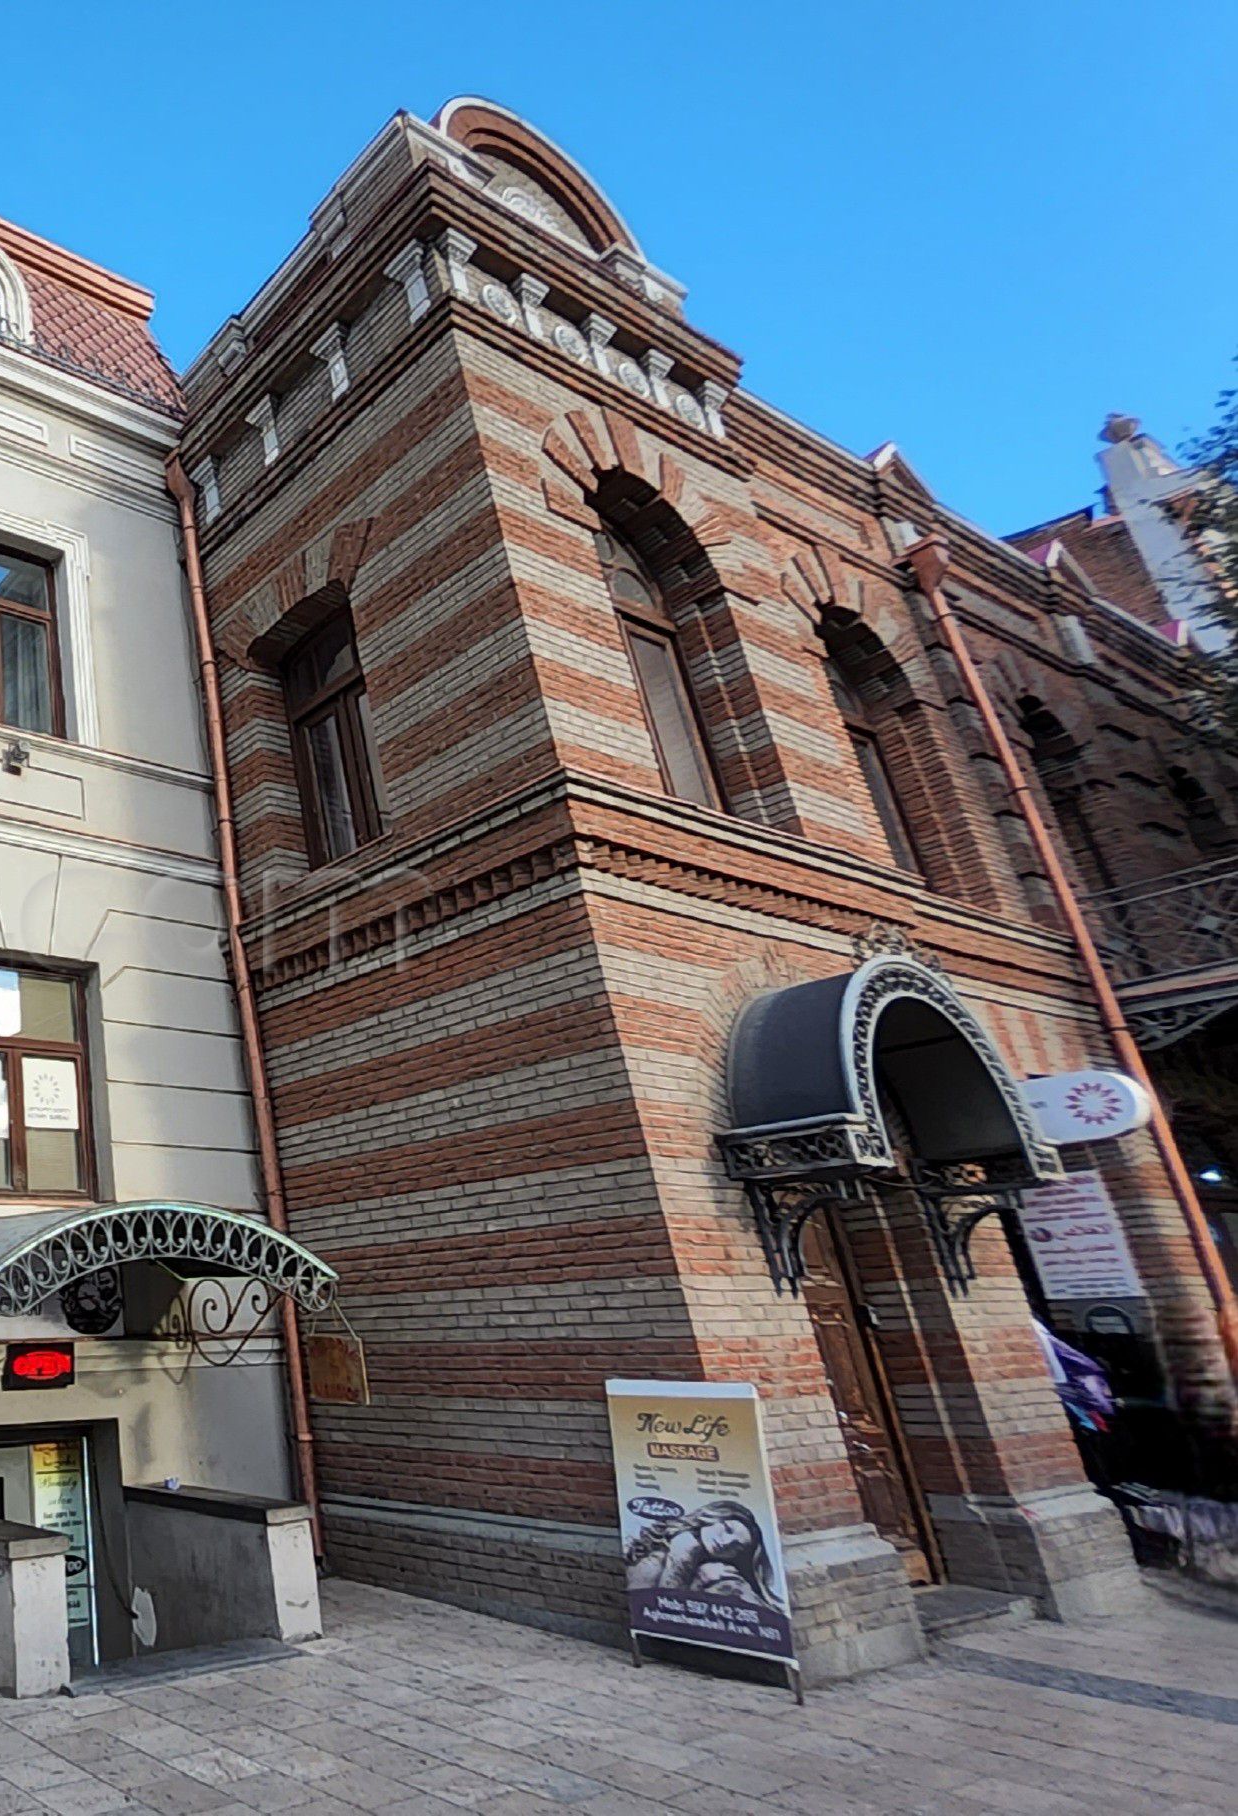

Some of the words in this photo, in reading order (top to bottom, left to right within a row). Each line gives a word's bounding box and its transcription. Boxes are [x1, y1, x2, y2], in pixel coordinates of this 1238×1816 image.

[636, 1412, 681, 1434] New
[683, 1414, 730, 1443] Life
[650, 1443, 716, 1460] MASSAGE
